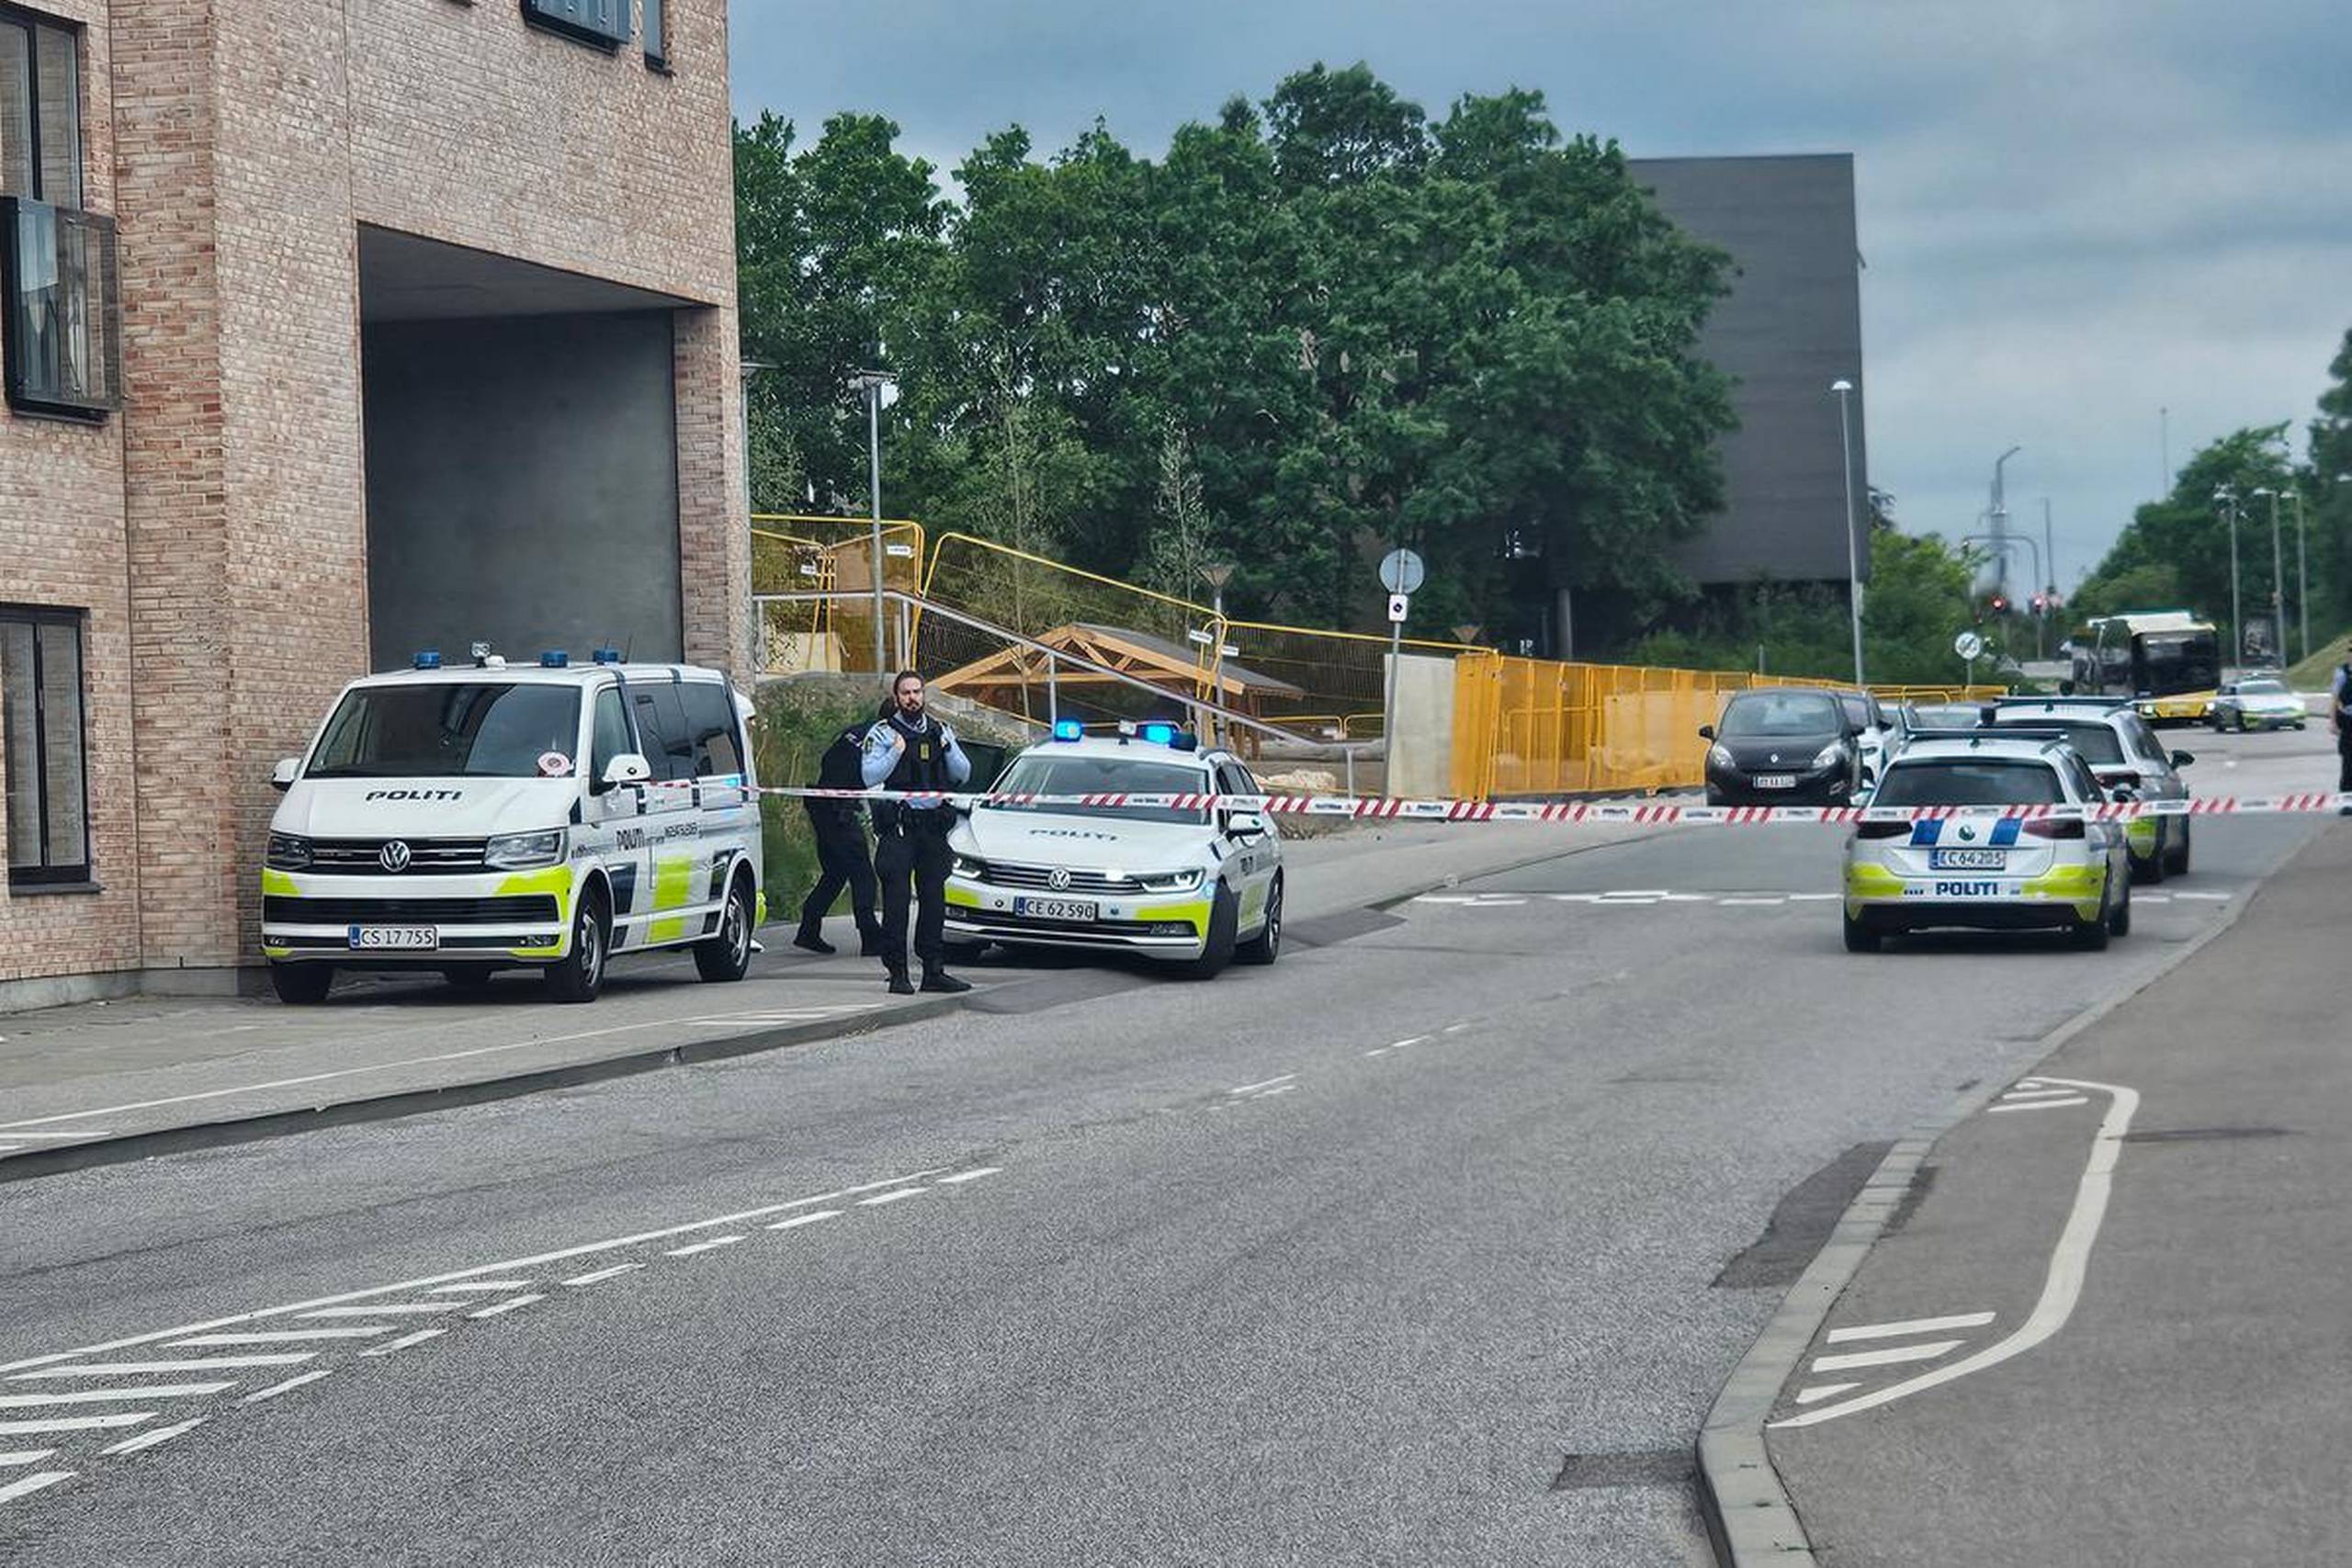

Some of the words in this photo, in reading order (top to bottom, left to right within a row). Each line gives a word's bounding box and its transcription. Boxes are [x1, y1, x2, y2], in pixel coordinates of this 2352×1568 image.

[366, 790, 462, 802] POLITI
[1936, 882, 1998, 896] POLITI
[1026, 900, 1044, 916] CE
[1047, 902, 1065, 917] 62
[1069, 904, 1093, 919] 590
[362, 930, 380, 945] CS
[386, 930, 401, 945] 17
[406, 930, 433, 945] 755
